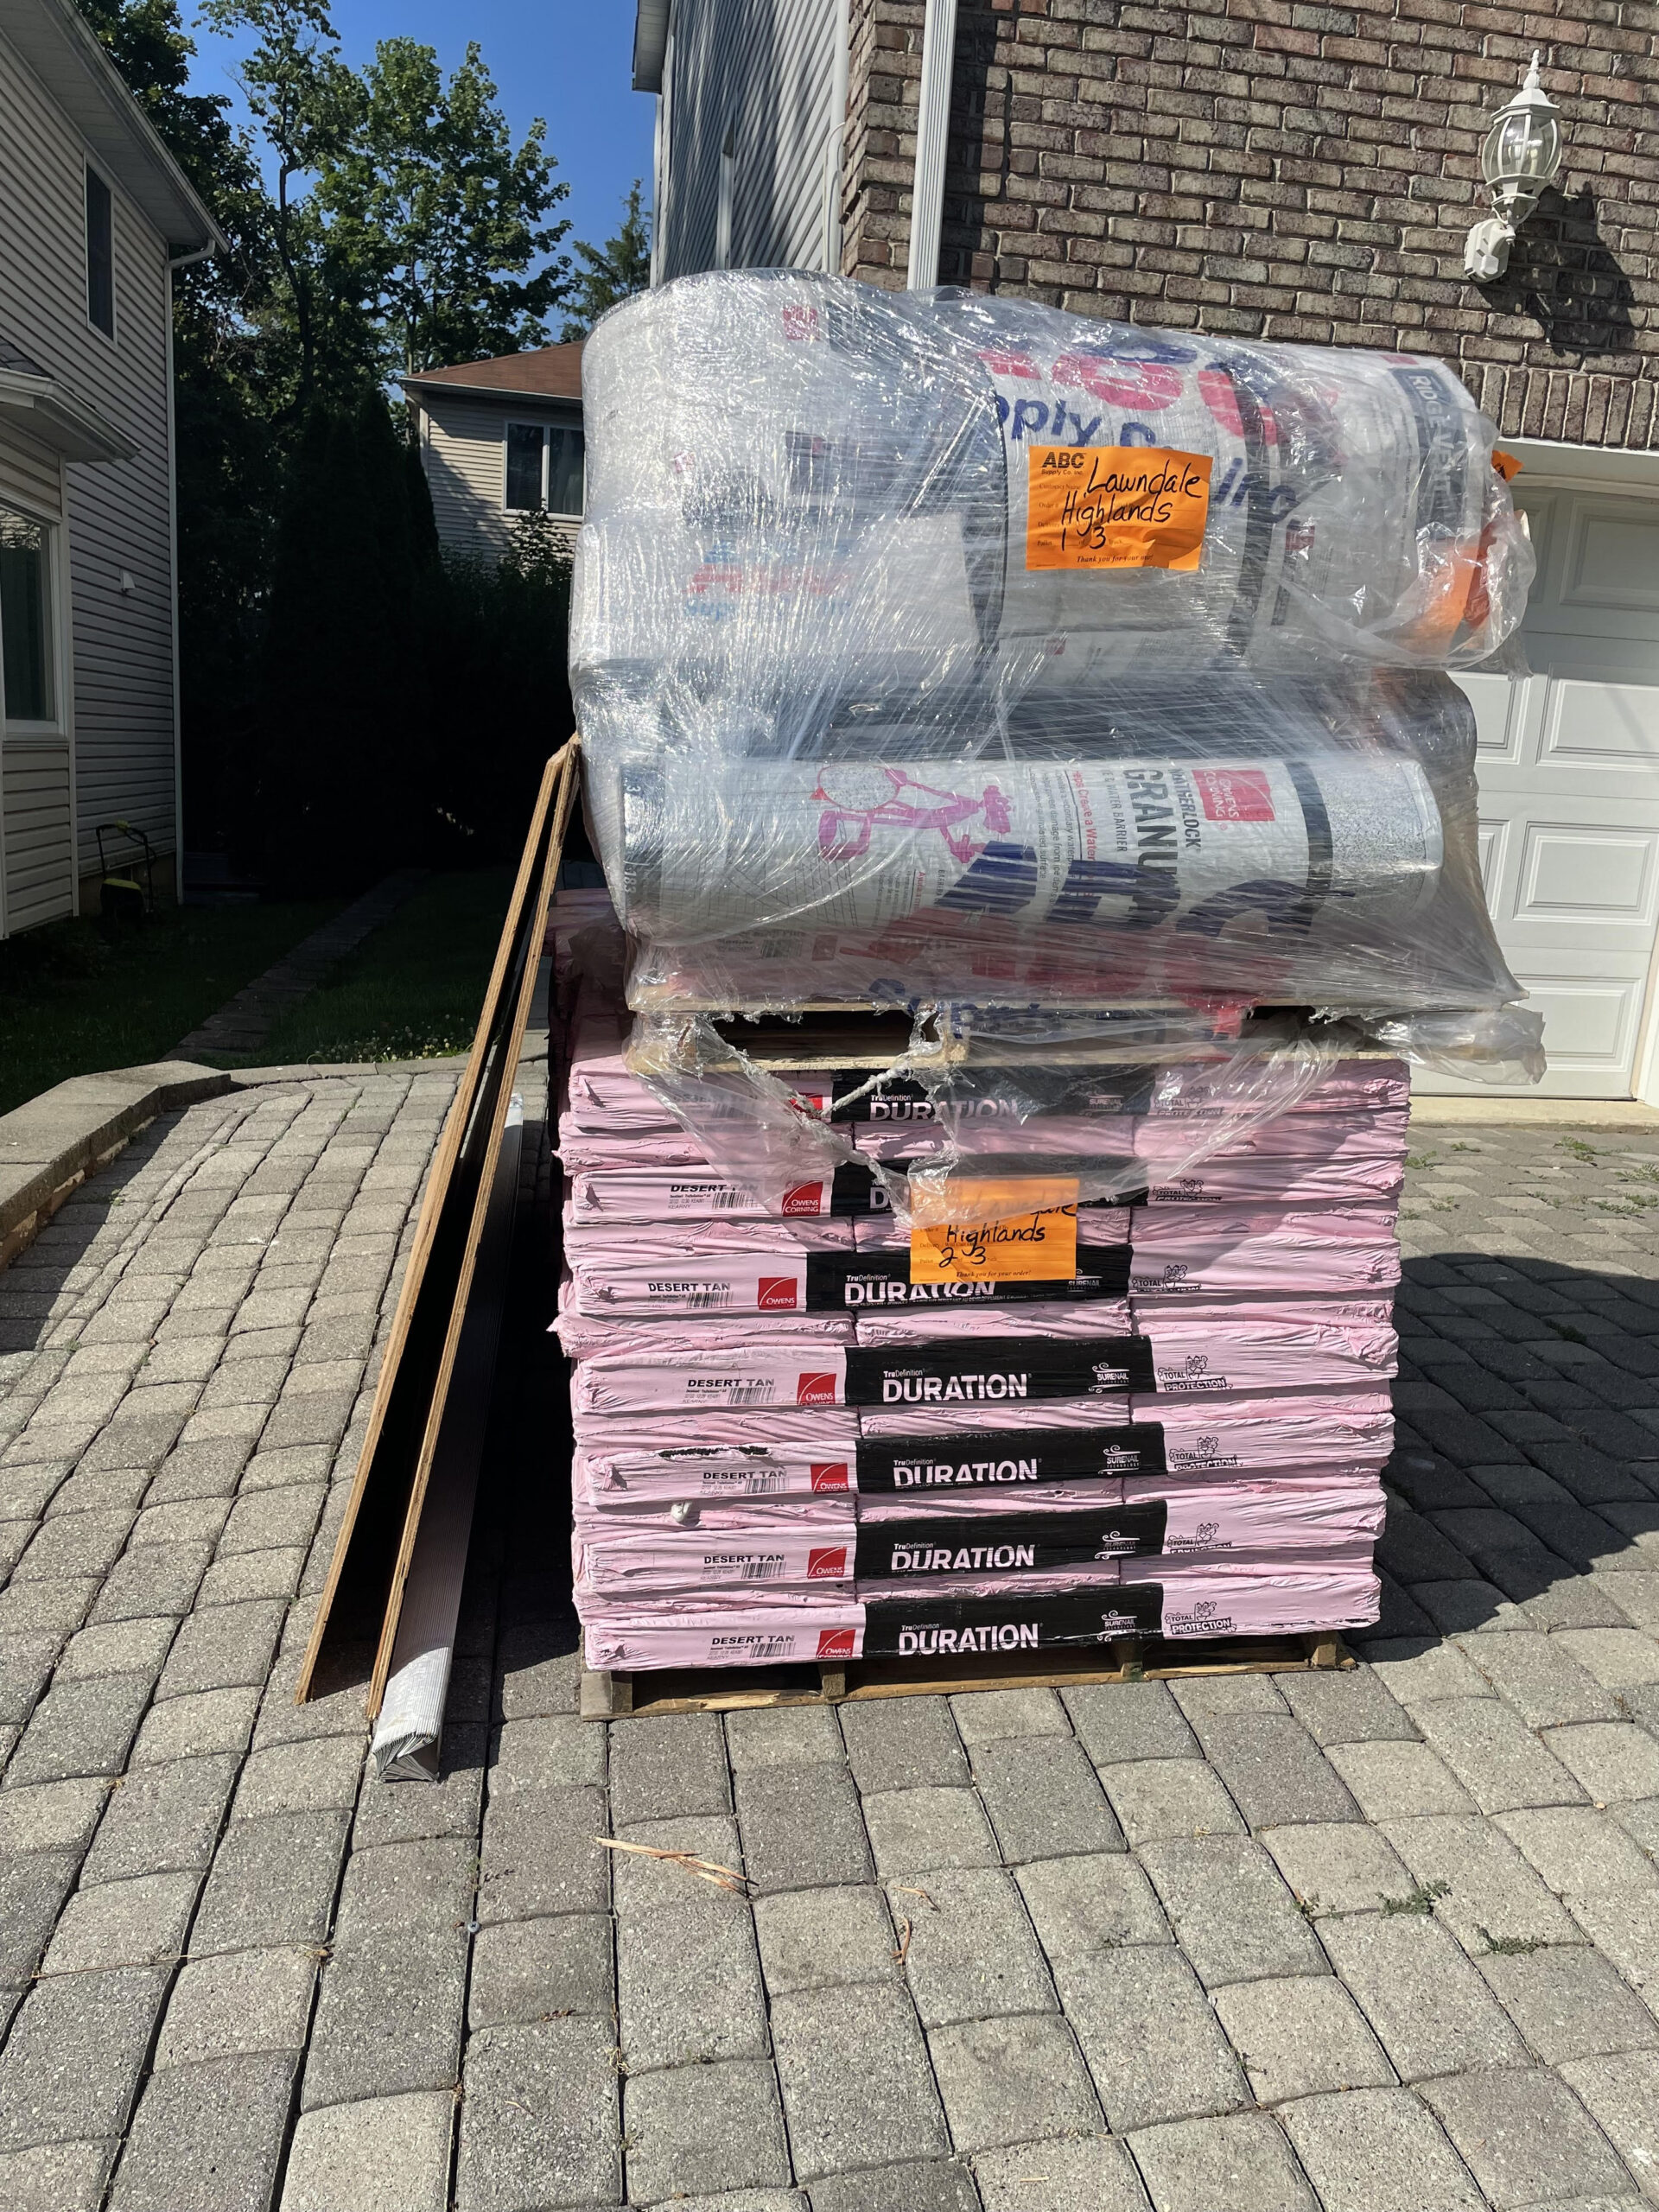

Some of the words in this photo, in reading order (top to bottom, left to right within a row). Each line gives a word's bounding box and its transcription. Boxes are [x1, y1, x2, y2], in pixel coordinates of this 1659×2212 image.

[1408, 375, 1446, 430] RIDGE
[1041, 451, 1086, 468] ABC
[1085, 455, 1202, 499] Lawndale
[1061, 490, 1173, 537] Highlands
[1089, 525, 1107, 550] 3
[1218, 779, 1240, 818] OWENS
[1047, 810, 1061, 842] damage
[1113, 811, 1128, 853] BARRIER
[1052, 842, 1062, 862] from
[1039, 849, 1049, 879] surface
[869, 1098, 1019, 1122] DURATION
[946, 1220, 1046, 1256] Highlands
[938, 1247, 958, 1268] 2
[970, 1245, 987, 1266] 3
[648, 1283, 698, 1292] DESERT
[702, 1282, 731, 1291] TAN
[844, 1281, 995, 1305] DURATION
[883, 1369, 924, 1378] TruDefinition
[1096, 1373, 1129, 1382] SURENAIL
[1164, 1371, 1185, 1380] TOTAL
[883, 1374, 1027, 1402] DURATION
[1166, 1379, 1227, 1391] PROTECTION
[1107, 1455, 1140, 1464] SURENAIL
[1175, 1452, 1198, 1460] TOTAL
[1175, 1458, 1236, 1471] PROTECTION
[893, 1459, 1037, 1487] DURATION
[893, 1542, 934, 1551] TruDefinition
[1173, 1538, 1194, 1547] TOTAL
[704, 1555, 752, 1564] DESERT
[891, 1545, 1035, 1571] DURATION
[901, 1623, 940, 1631] TruDefinition
[1104, 1619, 1135, 1628] SURENAIL
[1171, 1618, 1232, 1636] PROTECTION
[712, 1636, 764, 1645] DESERT
[899, 1623, 1039, 1656] DURATION
